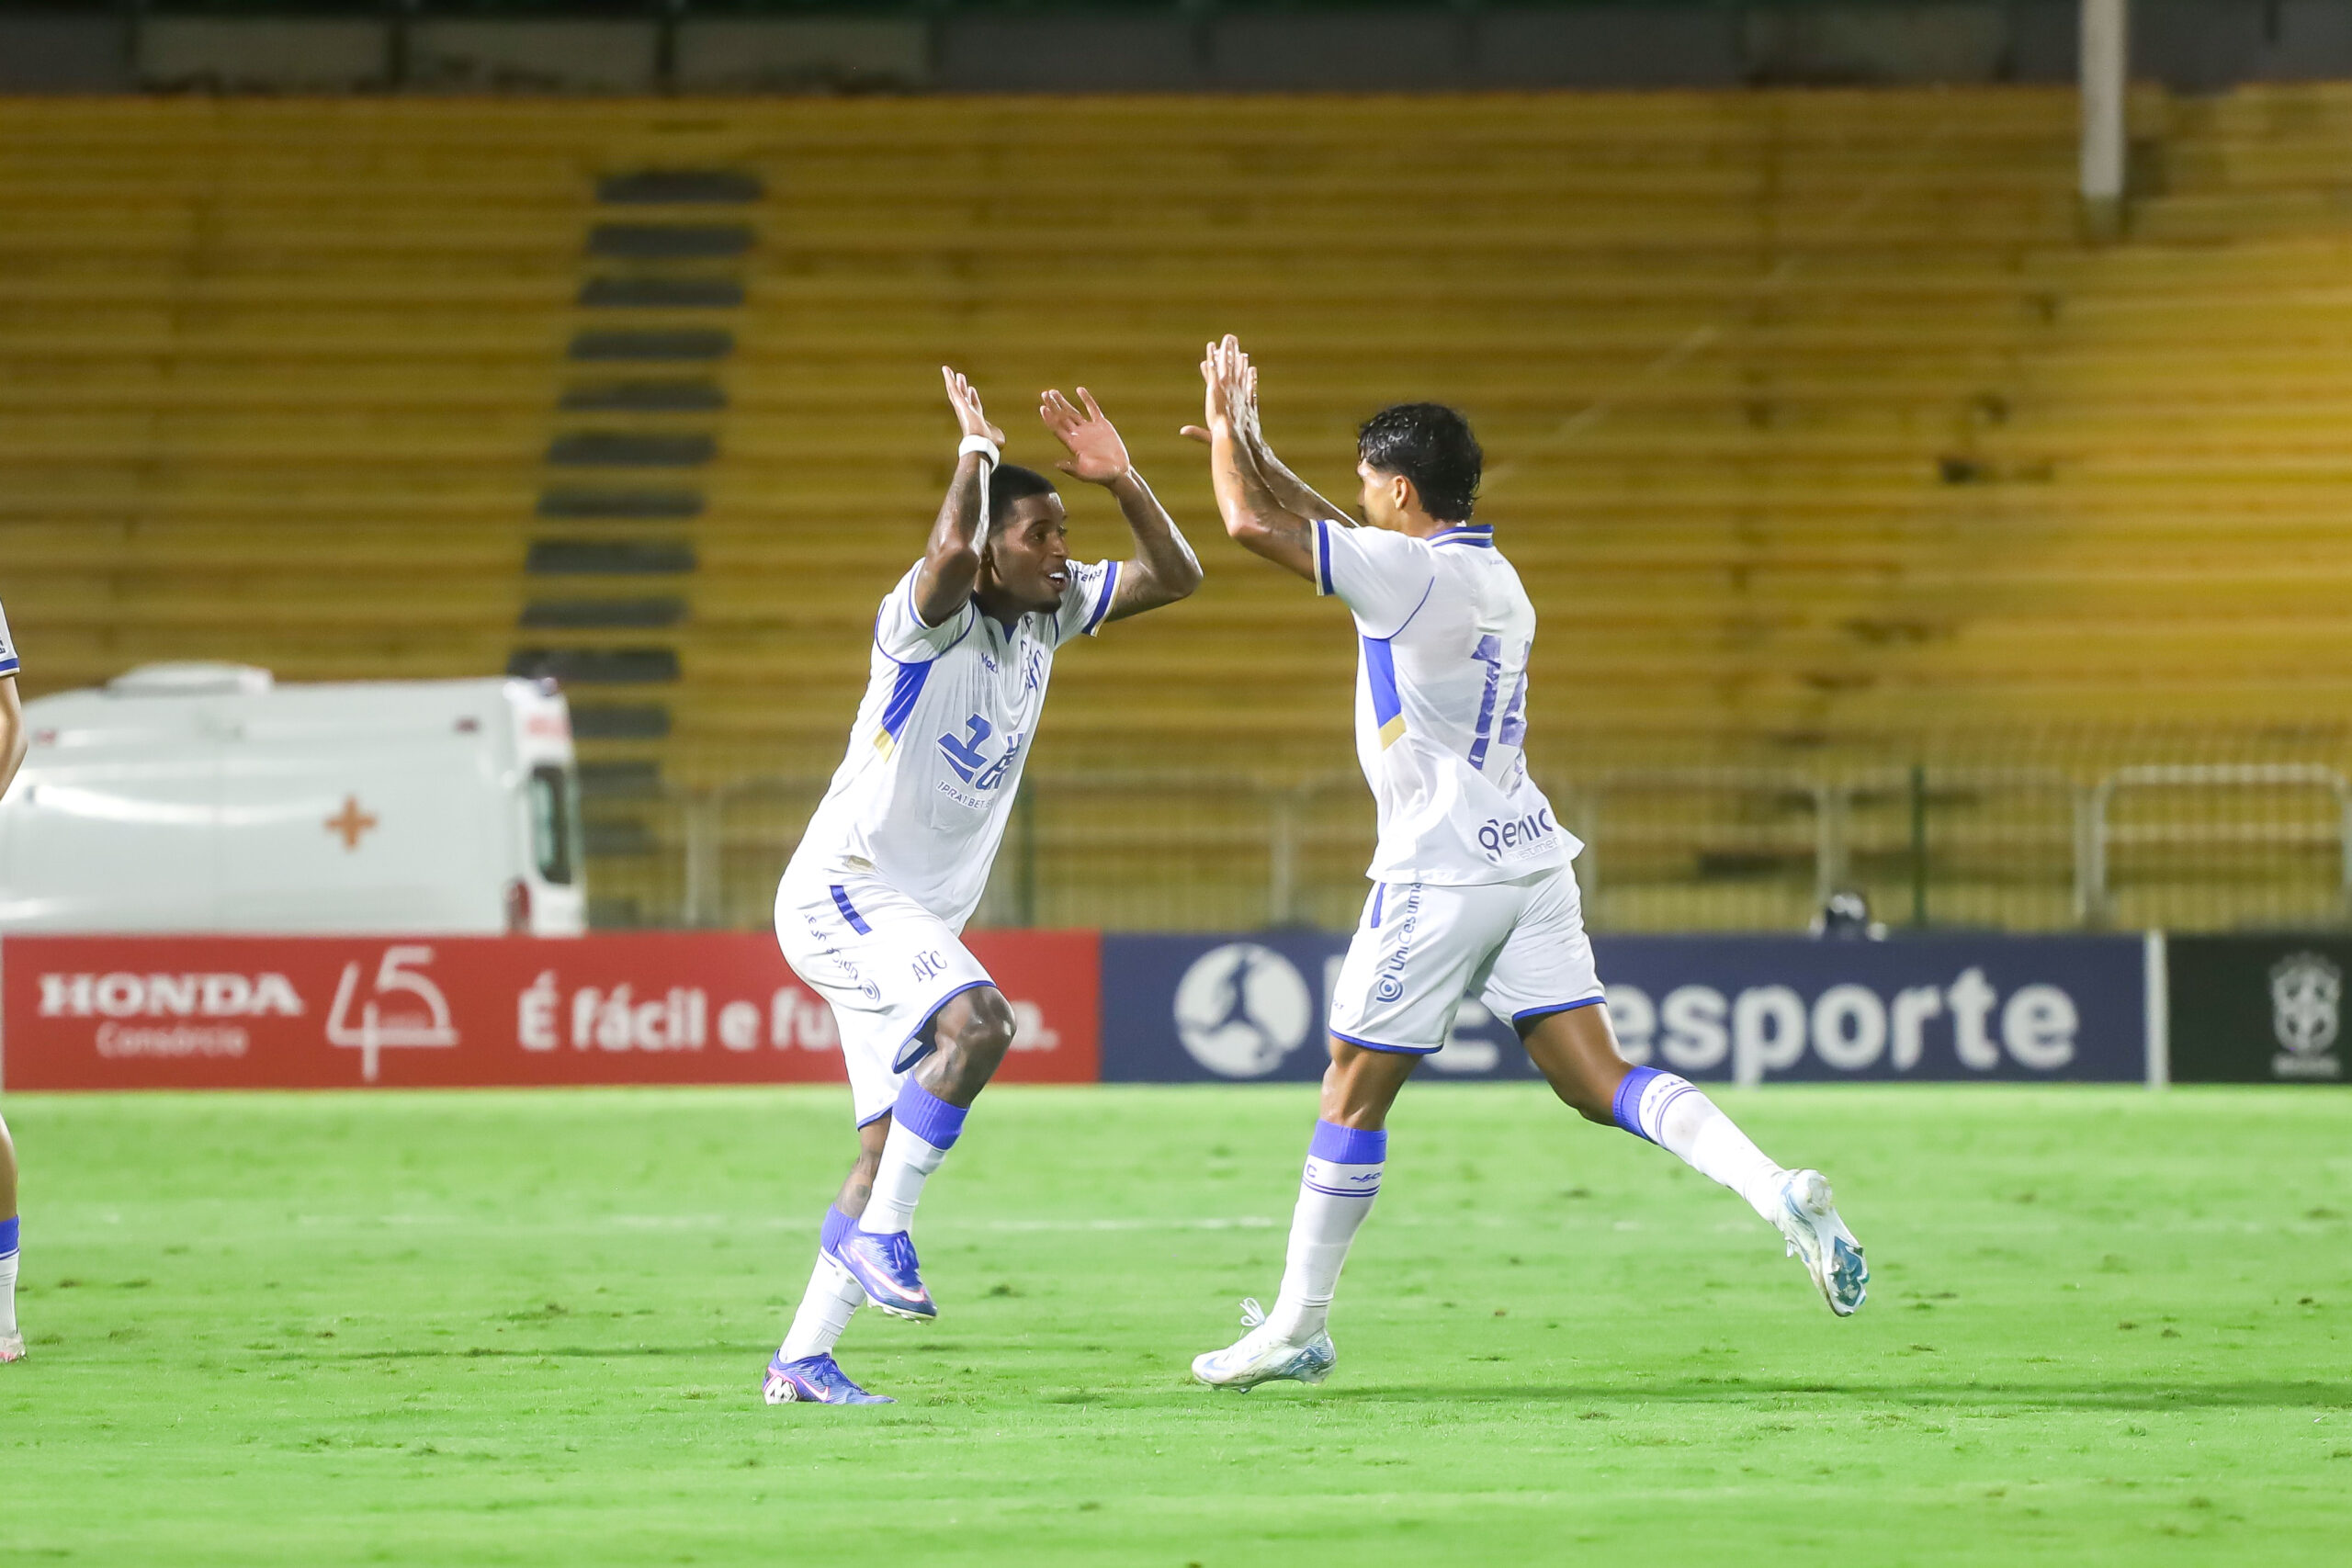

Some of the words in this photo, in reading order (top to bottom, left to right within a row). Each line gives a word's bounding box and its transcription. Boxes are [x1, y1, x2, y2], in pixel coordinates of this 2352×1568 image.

[39, 973, 303, 1017] HONDA
[911, 950, 947, 982] AFC
[326, 945, 459, 1082] 45
[517, 967, 560, 1050] É
[570, 982, 707, 1051] fácil
[718, 999, 762, 1051] e
